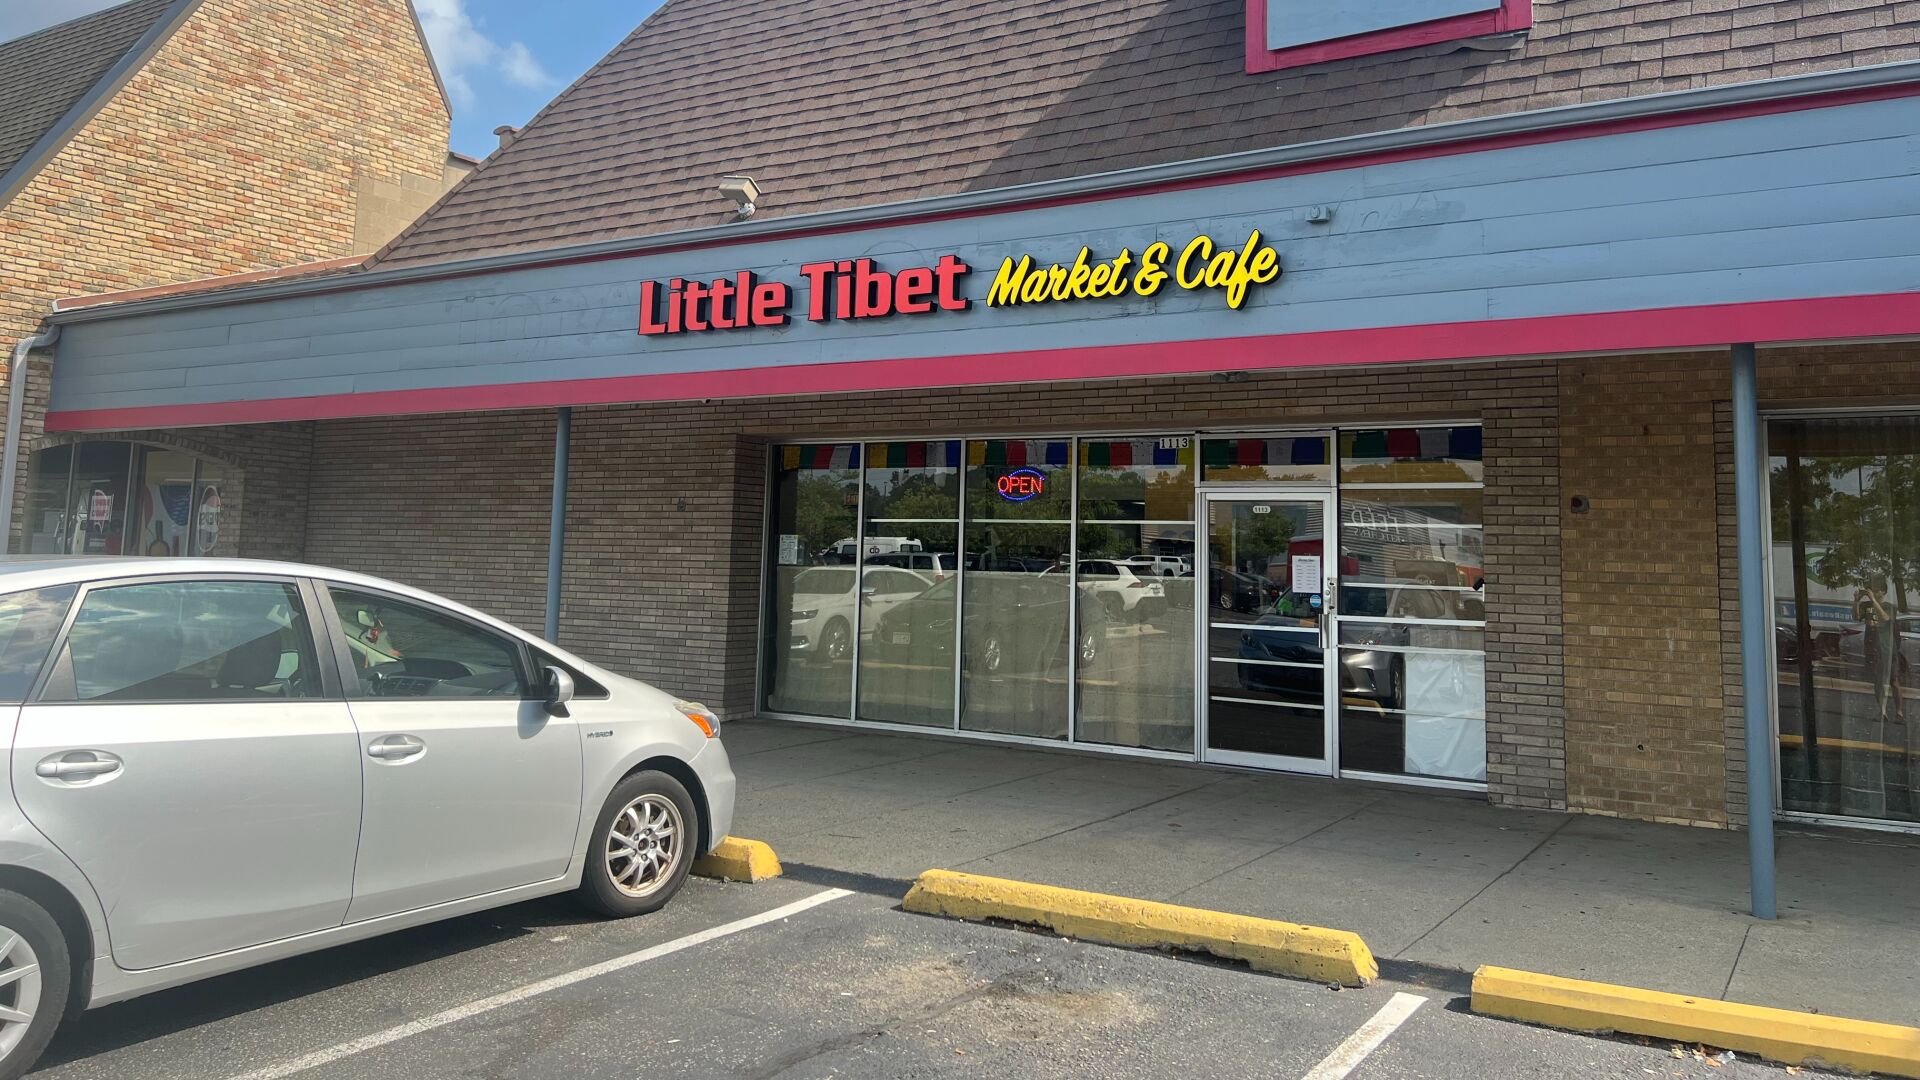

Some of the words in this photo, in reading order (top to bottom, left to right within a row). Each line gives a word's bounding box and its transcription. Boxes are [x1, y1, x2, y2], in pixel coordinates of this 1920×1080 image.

[637, 269, 792, 336] Little
[800, 254, 973, 322] Tibet
[986, 246, 1132, 307] Market
[1133, 240, 1169, 296] &
[1176, 228, 1283, 311] Cafe
[1161, 438, 1188, 449] 1113
[997, 476, 1043, 494] OPEN
